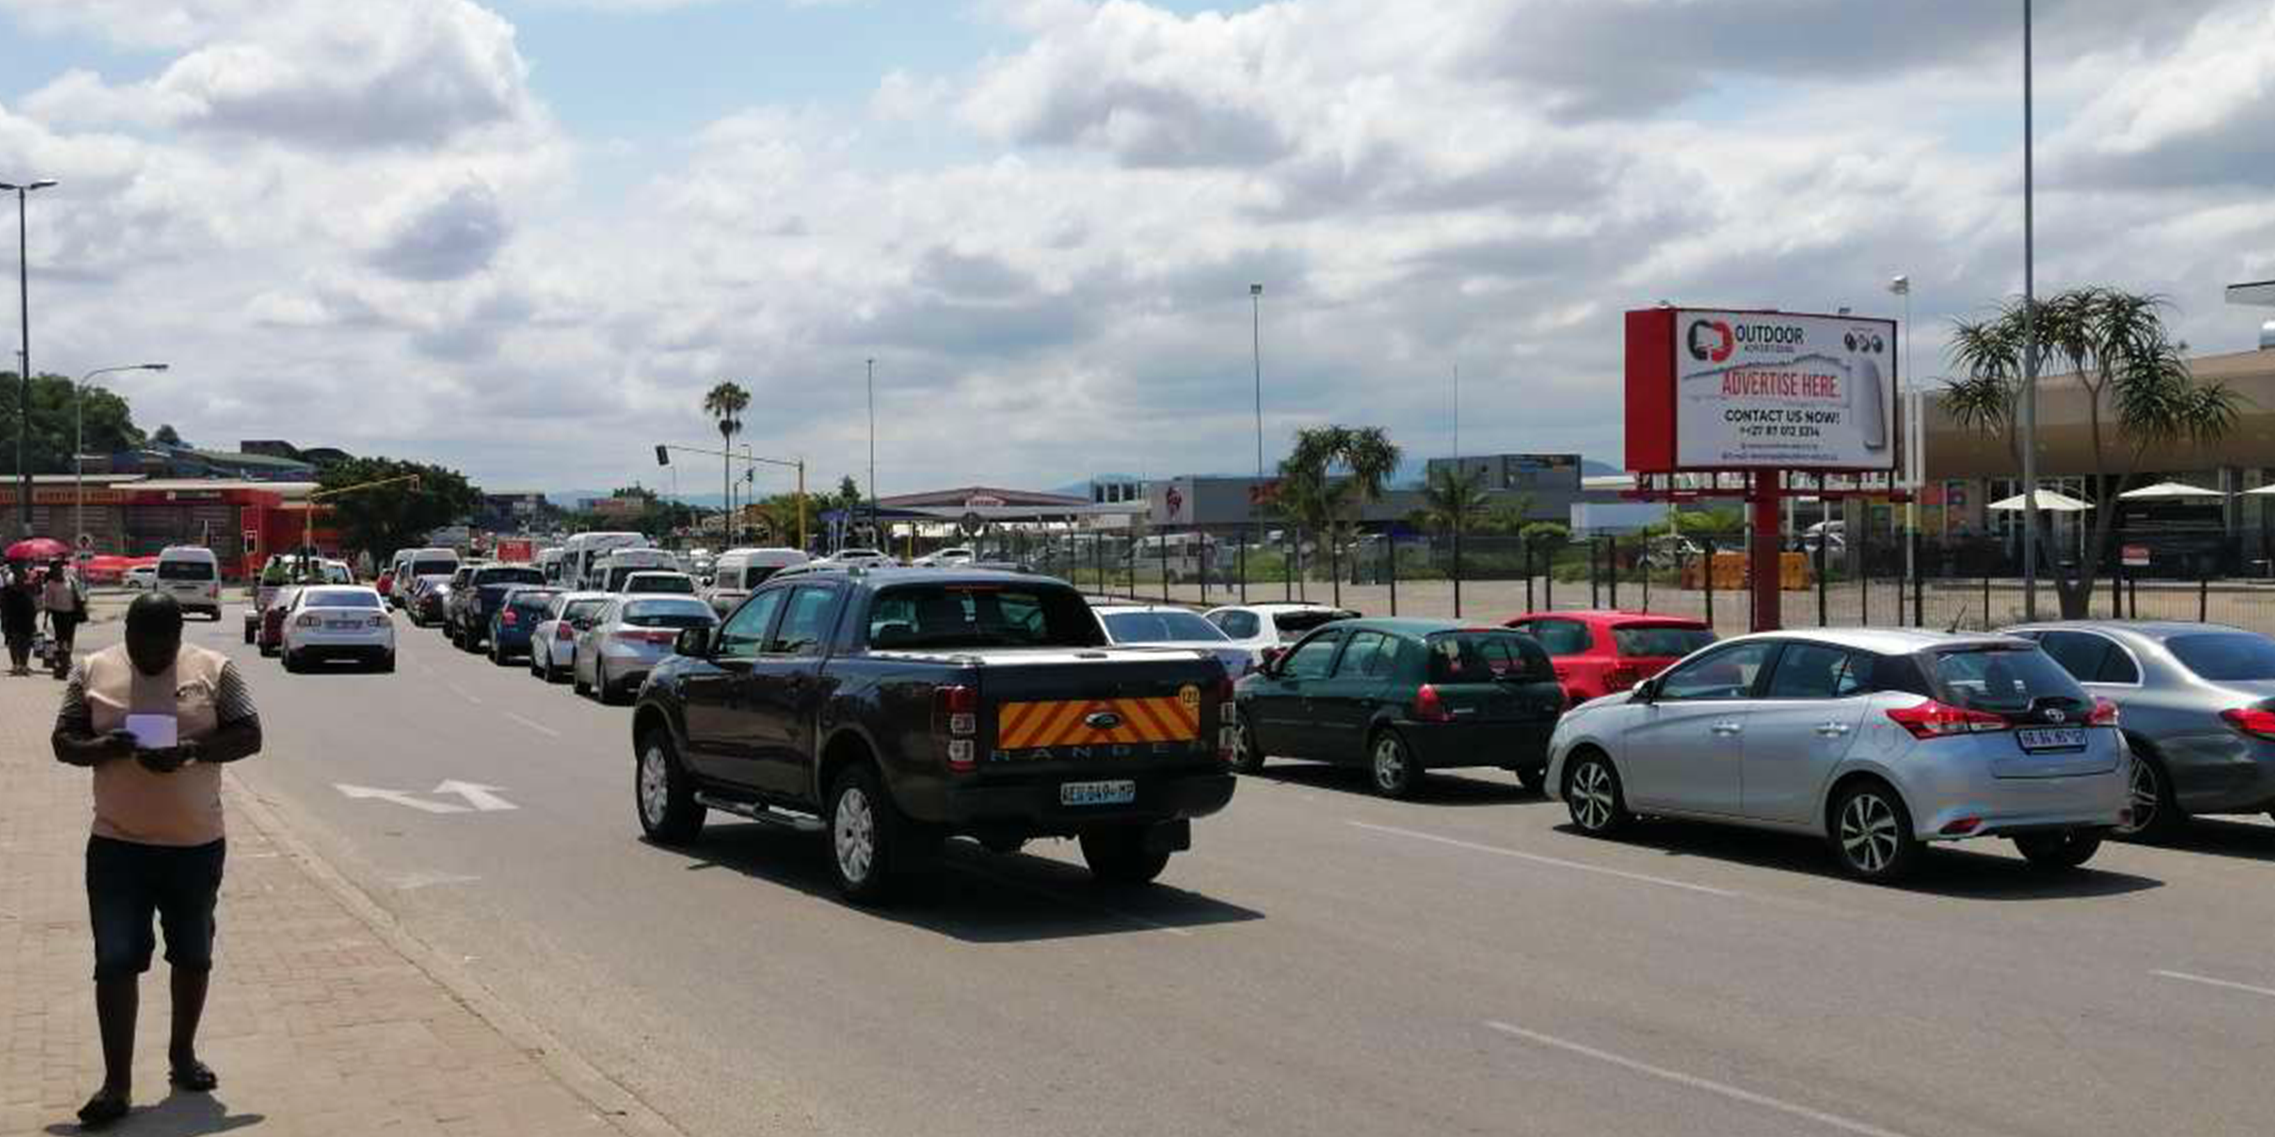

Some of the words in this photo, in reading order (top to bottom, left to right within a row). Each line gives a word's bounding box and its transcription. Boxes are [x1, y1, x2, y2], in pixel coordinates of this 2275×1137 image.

[1736, 324, 1804, 344] OUTDOOR
[1723, 371, 1798, 396] ADVERTISE
[1802, 375, 1841, 398] HERE.
[1725, 410, 1784, 422] CONTACT
[1787, 410, 1802, 422] US
[1806, 412, 1840, 424] NOW!
